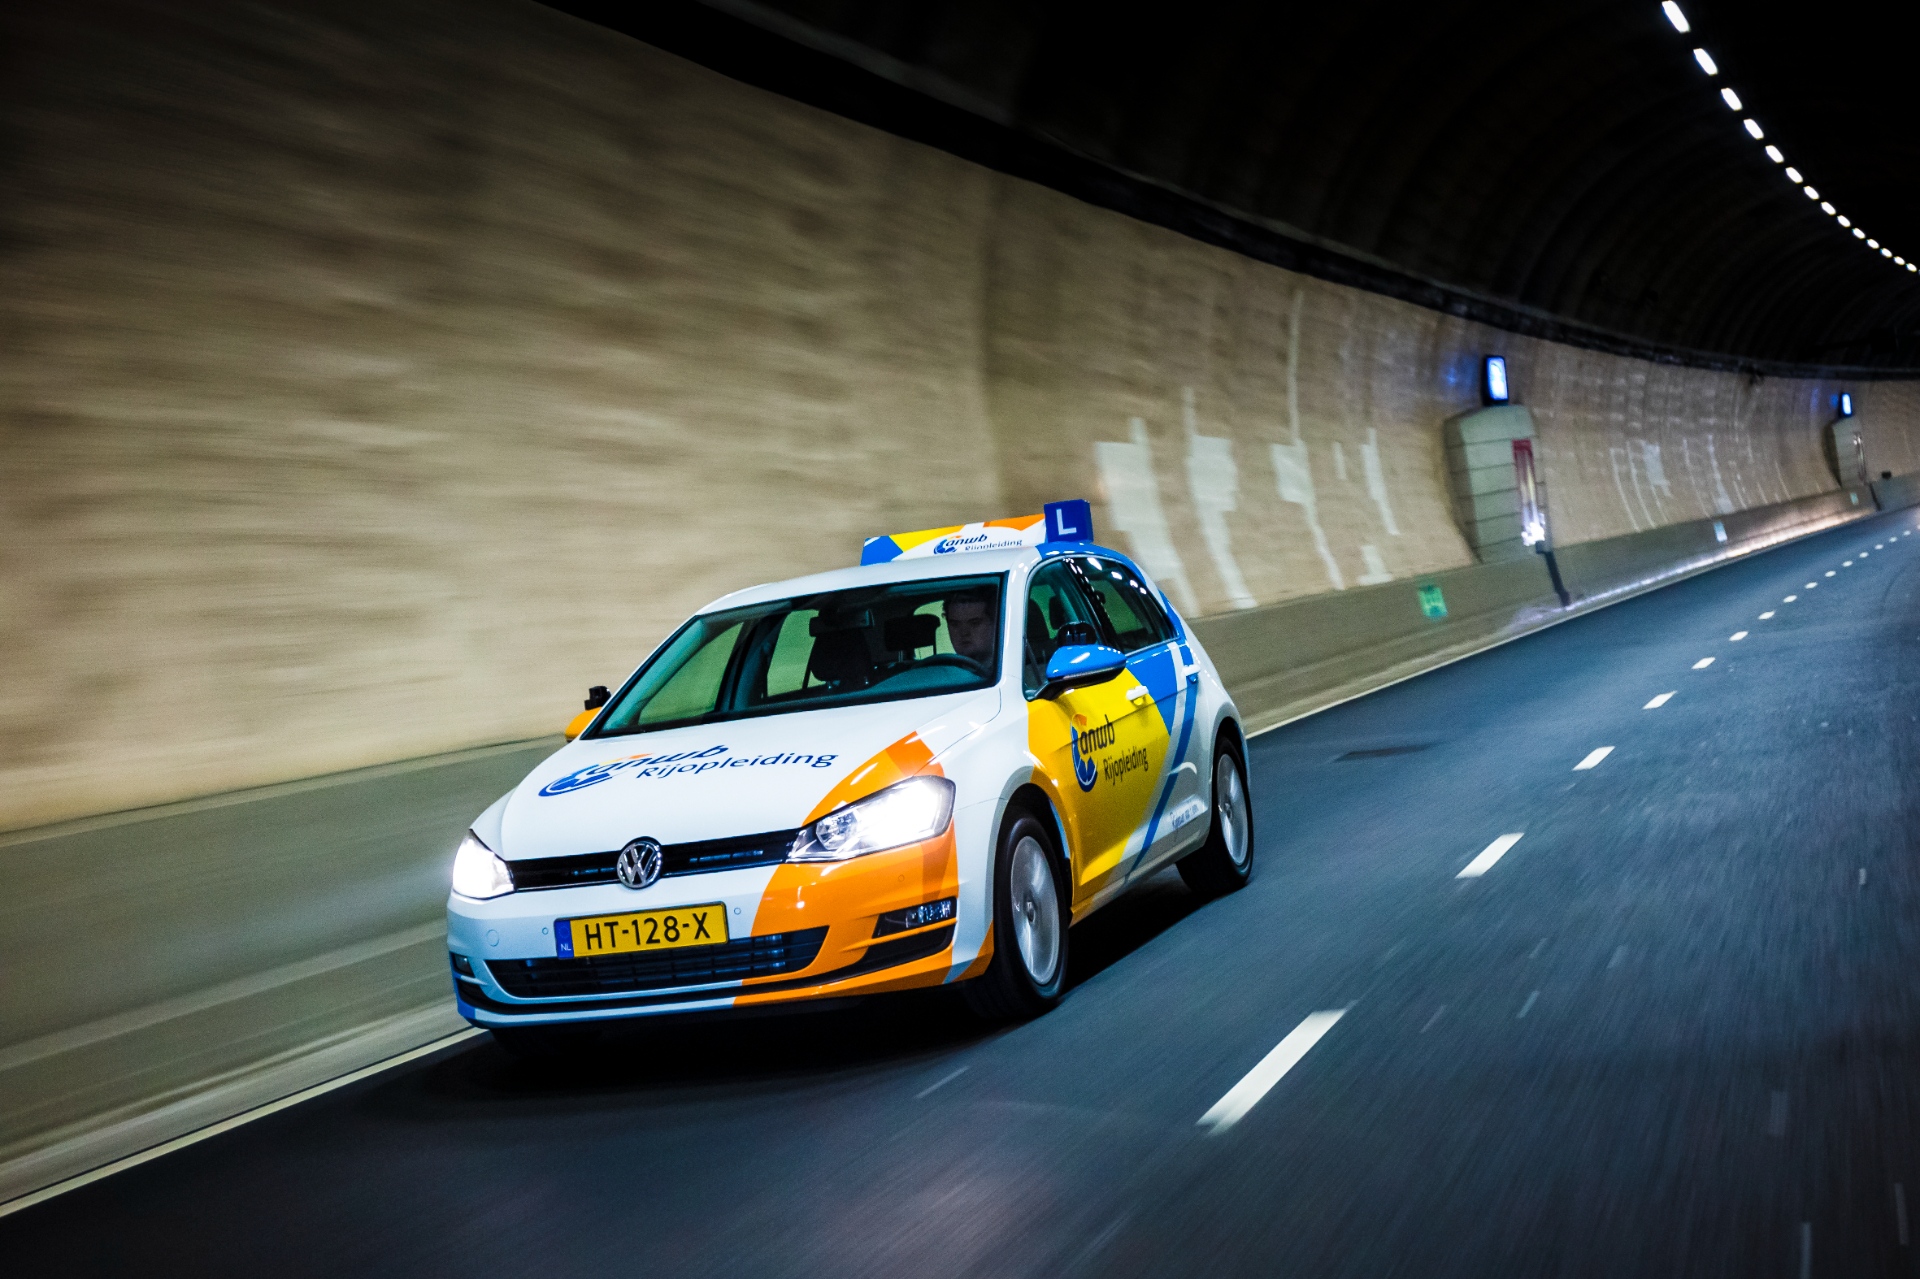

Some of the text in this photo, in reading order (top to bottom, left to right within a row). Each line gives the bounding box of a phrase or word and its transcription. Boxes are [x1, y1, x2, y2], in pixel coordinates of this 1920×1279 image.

[1056, 508, 1077, 535] L
[945, 534, 988, 547] anwb
[1080, 714, 1115, 755] anwb
[590, 745, 729, 774] anwb
[636, 753, 838, 779] Rijopleiding
[1103, 746, 1149, 786] Rijopleiding
[560, 912, 711, 951] NL HT-128-X
